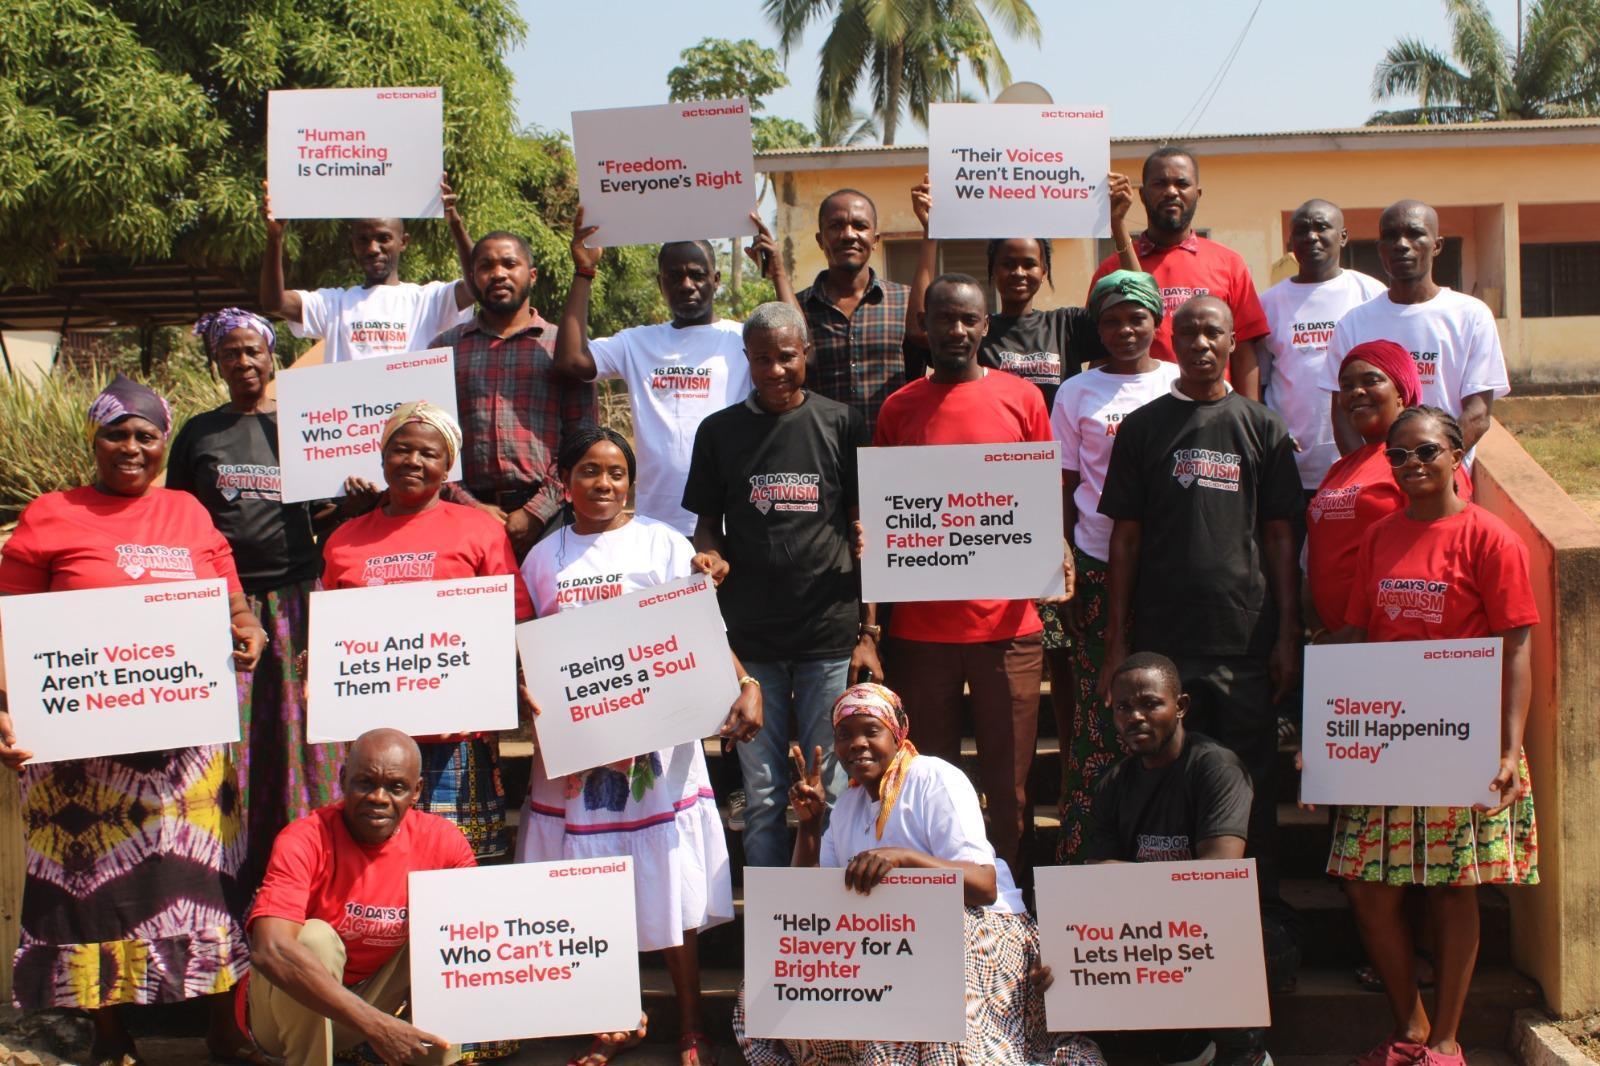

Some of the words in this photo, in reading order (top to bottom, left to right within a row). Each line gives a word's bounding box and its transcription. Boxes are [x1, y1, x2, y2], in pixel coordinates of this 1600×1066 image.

[298, 128, 365, 141] “Human
[298, 145, 388, 162] Trafficking
[951, 148, 1003, 162] “Their
[1006, 148, 1064, 163] Voices
[298, 163, 311, 176] Is
[315, 162, 392, 176] Criminal”
[598, 157, 687, 174] “Freedom.
[955, 167, 1008, 181] Aren’t
[1013, 166, 1085, 184] Enough,
[600, 174, 692, 194] Everyone’s
[696, 170, 742, 189] Right
[955, 185, 985, 199] We
[989, 185, 1036, 199] Need
[1040, 185, 1096, 199] Yours”
[351, 321, 363, 329] 16
[364, 321, 391, 329] DAYS
[1293, 323, 1305, 331] 16
[1307, 321, 1335, 330] DAYS
[351, 330, 407, 342] ACTIVISM
[1422, 352, 1438, 361] OF
[653, 367, 665, 375] 16
[667, 366, 694, 375] DAYS
[697, 367, 712, 375] OF
[651, 376, 711, 390] ACTIVISM
[301, 408, 348, 424] “Help
[1105, 414, 1120, 422] 16
[302, 428, 342, 443] Who
[346, 419, 389, 437] Can’
[1174, 449, 1190, 460] 16
[1191, 448, 1222, 463] DAYS
[1223, 453, 1241, 465] OF
[217, 465, 234, 474] 16
[235, 465, 267, 475] DAYS
[750, 475, 766, 487] 16
[766, 472, 800, 485] DAYS
[801, 473, 819, 485] OF
[1173, 460, 1240, 481] ACTIVISM
[216, 473, 281, 491] ACTIVISM
[750, 484, 818, 503] ACTIVISM
[884, 495, 943, 512] “Every
[947, 492, 1019, 508] Mother,
[886, 513, 936, 530] Child,
[941, 513, 975, 527] Son
[980, 510, 1014, 526] and
[886, 532, 944, 548] Father
[949, 531, 1032, 547] Deserves
[115, 544, 133, 554] 16
[136, 545, 169, 557] DAYS
[170, 547, 190, 558] OF
[367, 557, 381, 566] 16
[383, 553, 415, 564] DAYS
[417, 552, 436, 561] OF
[887, 550, 975, 568] Freedom”
[362, 562, 434, 580] ACTIVISM
[557, 580, 570, 590] 16
[572, 575, 603, 587] DAYS
[606, 573, 623, 583] OF
[1380, 579, 1393, 590] 16
[1394, 579, 1426, 592] DAYS
[1427, 581, 1448, 594] OF
[556, 583, 622, 605] ACTIVISM
[1377, 590, 1445, 613] ACTIVISM
[335, 640, 379, 655] “You
[384, 633, 424, 651] And
[430, 632, 466, 648] Me,
[33, 648, 99, 669] “Their
[104, 643, 176, 663] Voices
[340, 659, 380, 676] Lets
[387, 654, 431, 673] Help
[437, 651, 470, 668] Set
[560, 653, 625, 679] “Being
[628, 635, 678, 662] Used
[41, 670, 109, 692] Aren’t
[115, 661, 203, 685] Enough,
[334, 680, 390, 697] Them
[396, 673, 448, 692] Free”
[565, 672, 633, 701] Leaves
[637, 669, 649, 682] a
[653, 652, 696, 678] Soul
[43, 697, 80, 714] We
[86, 688, 145, 710] Need
[150, 681, 217, 703] Yours”
[570, 687, 650, 722] Bruised”
[1326, 698, 1406, 718] “Slavery.
[1326, 719, 1359, 737] Still
[1364, 718, 1470, 741] Happening
[1326, 742, 1389, 764] Today”
[345, 902, 363, 917] 16
[364, 906, 396, 920] DAYS
[440, 921, 499, 943] “Help
[504, 918, 575, 937] Those,
[773, 913, 831, 935] “Help
[835, 913, 916, 932] Abolish
[1066, 924, 1113, 941] “You
[1119, 921, 1163, 940] And
[1168, 921, 1208, 939] Me,
[440, 946, 491, 965] Who
[497, 940, 553, 961] Can’t
[559, 936, 608, 957] Help
[779, 936, 856, 959] Slavery
[861, 937, 891, 955] for
[896, 938, 913, 955] A
[1074, 945, 1118, 963] Lets
[1124, 944, 1172, 965] Help
[1178, 943, 1215, 960] Set
[441, 961, 580, 989] Themselves”
[774, 960, 860, 982] Brighter
[1070, 968, 1131, 986] Them
[1136, 966, 1192, 984] Free”
[774, 983, 893, 1002] Tomorrow”
